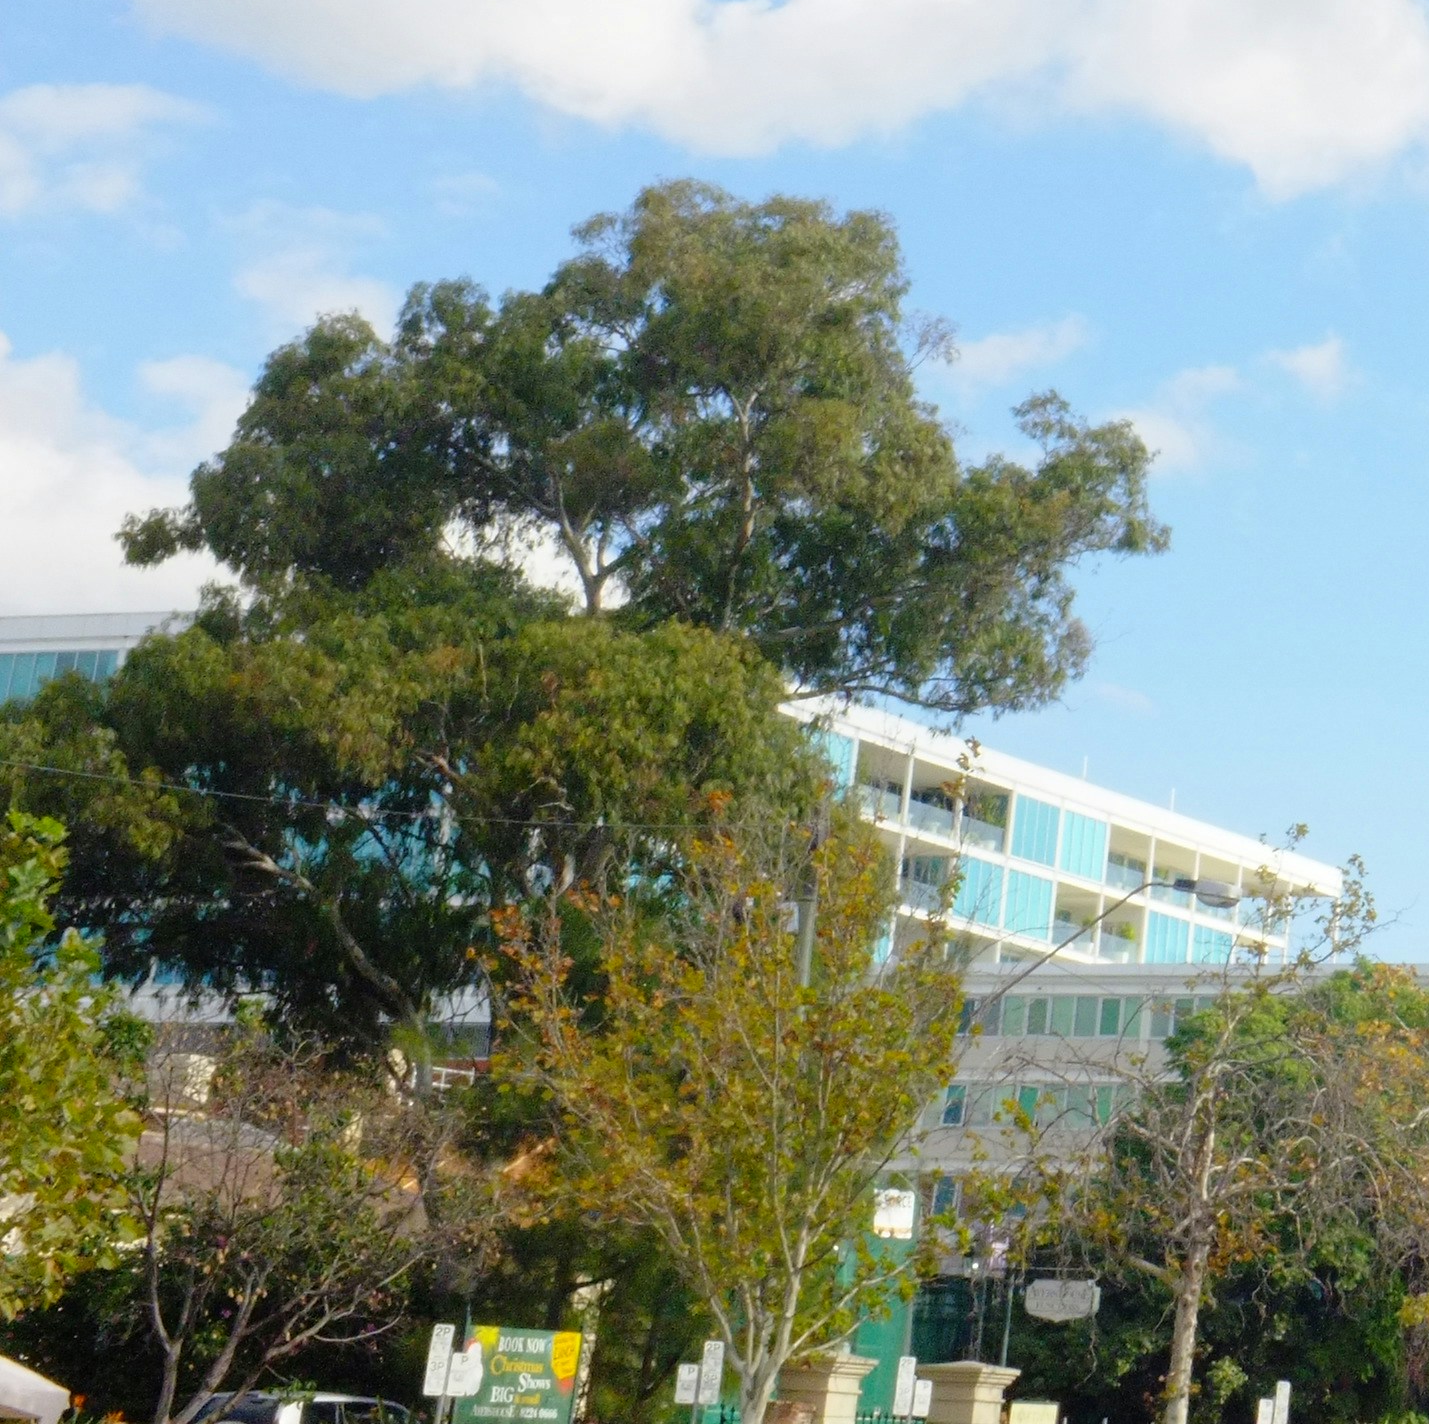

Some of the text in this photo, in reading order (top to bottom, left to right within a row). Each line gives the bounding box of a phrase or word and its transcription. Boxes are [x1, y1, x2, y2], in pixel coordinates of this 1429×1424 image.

[435, 1326, 451, 1337] 2P
[498, 1336, 525, 1353] BOOK
[517, 1372, 552, 1394] Shows
[490, 1385, 515, 1404] BIG
